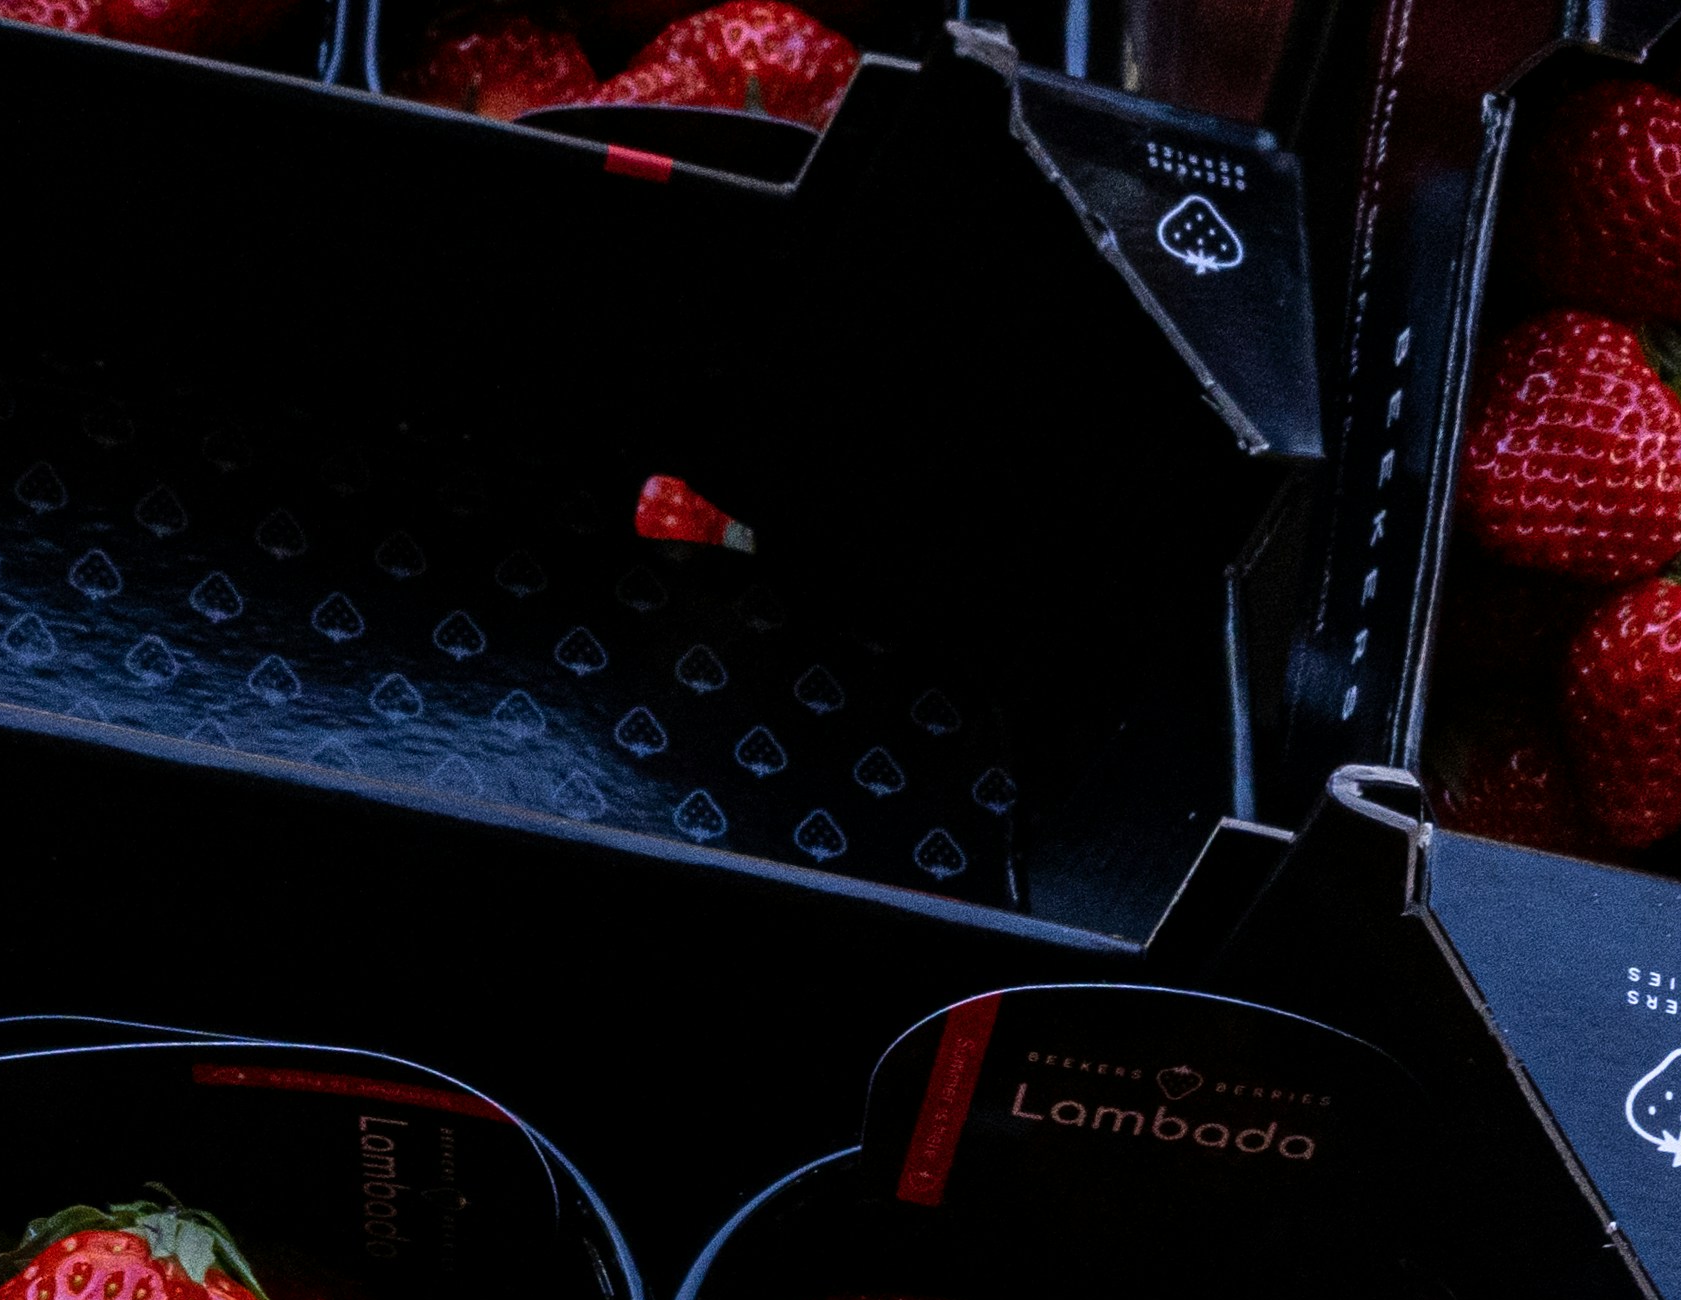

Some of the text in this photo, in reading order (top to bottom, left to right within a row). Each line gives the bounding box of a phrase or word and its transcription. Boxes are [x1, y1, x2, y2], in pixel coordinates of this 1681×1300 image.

[1343, 326, 1411, 721] BEEKERS
[1010, 1081, 1317, 1162] Lambada
[1027, 1050, 1332, 1107] BEEKERS BERRIES
[357, 1114, 407, 1260] Lambada
